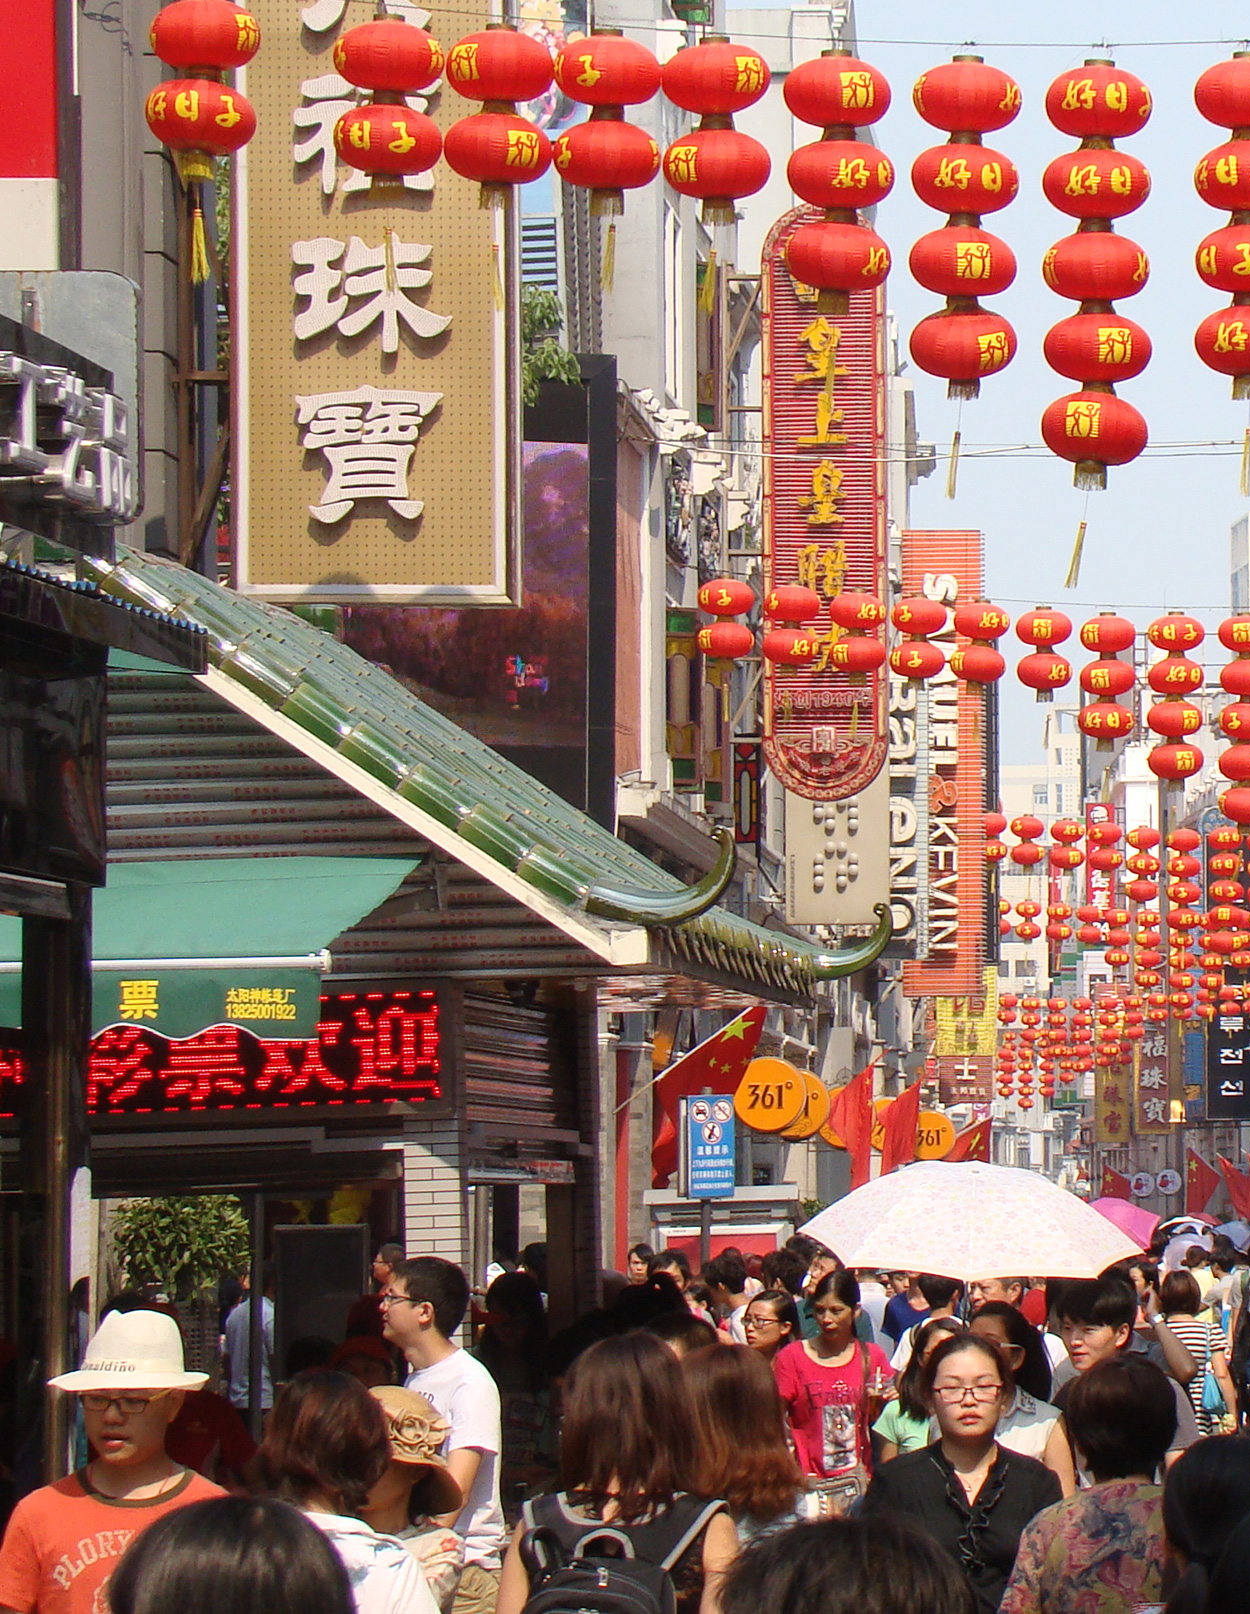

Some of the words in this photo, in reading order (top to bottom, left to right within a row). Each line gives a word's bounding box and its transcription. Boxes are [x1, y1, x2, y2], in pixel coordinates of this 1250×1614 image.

[293, 0, 453, 523] 珠寶
[928, 817, 959, 950] KEVIN
[119, 979, 160, 1021] 票
[225, 1003, 297, 1021] 13825001922
[747, 1080, 793, 1111] 361°
